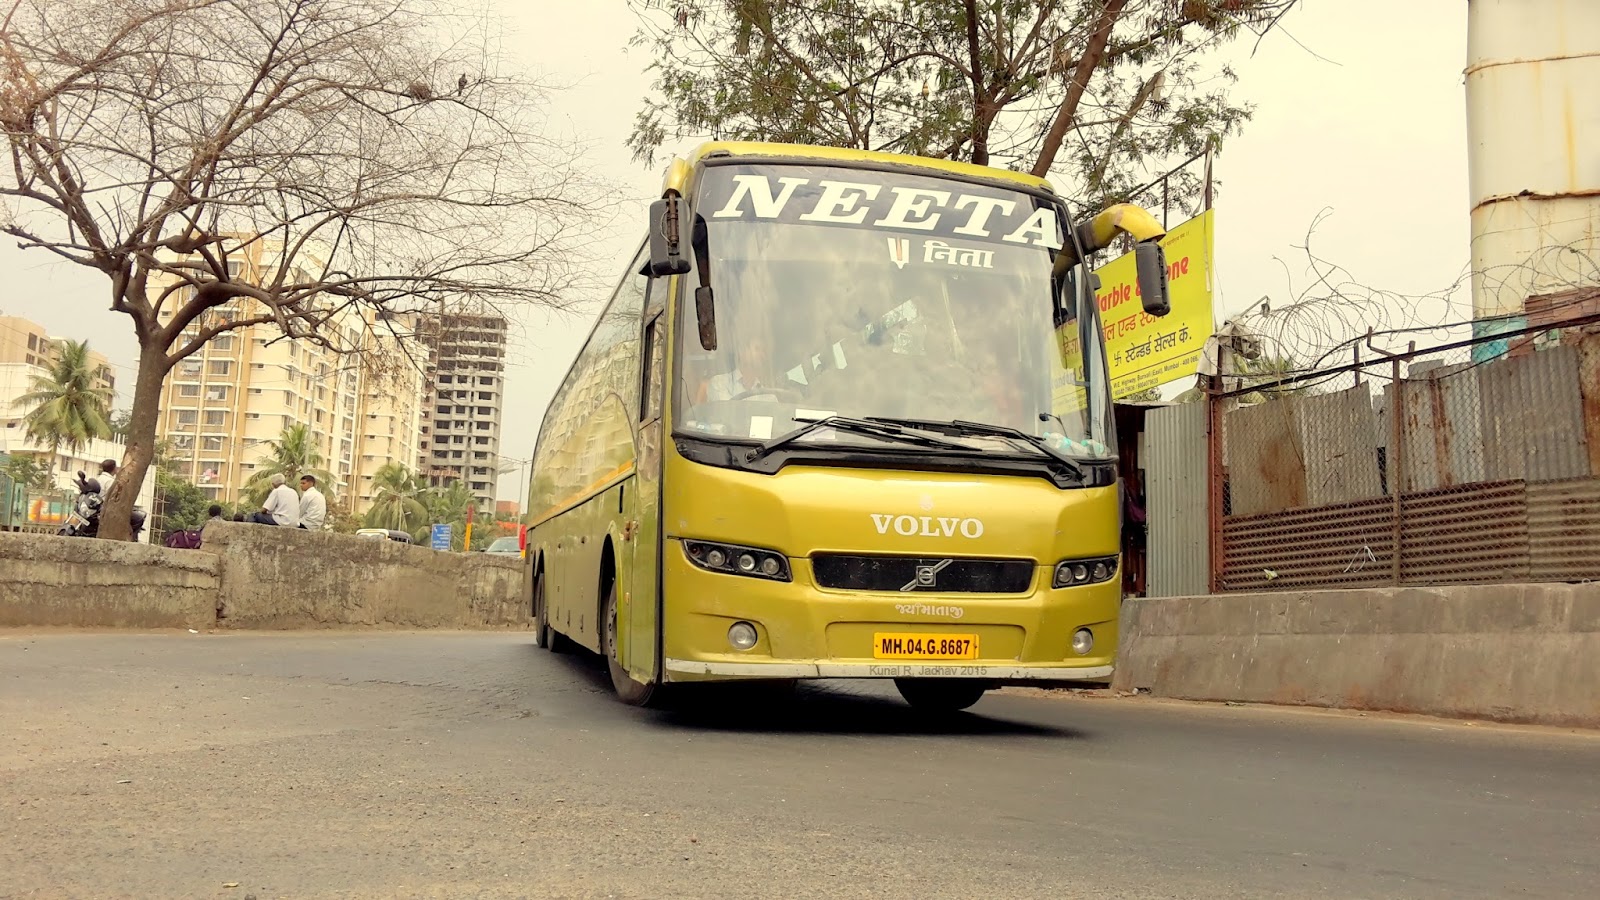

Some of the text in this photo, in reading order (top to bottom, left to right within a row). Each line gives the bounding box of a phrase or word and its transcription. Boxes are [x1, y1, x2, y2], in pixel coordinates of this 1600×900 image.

[712, 174, 1064, 250] NEETA
[922, 241, 995, 268] निता
[870, 513, 984, 539] VOLVO
[882, 638, 970, 655] MH.04.G.8687
